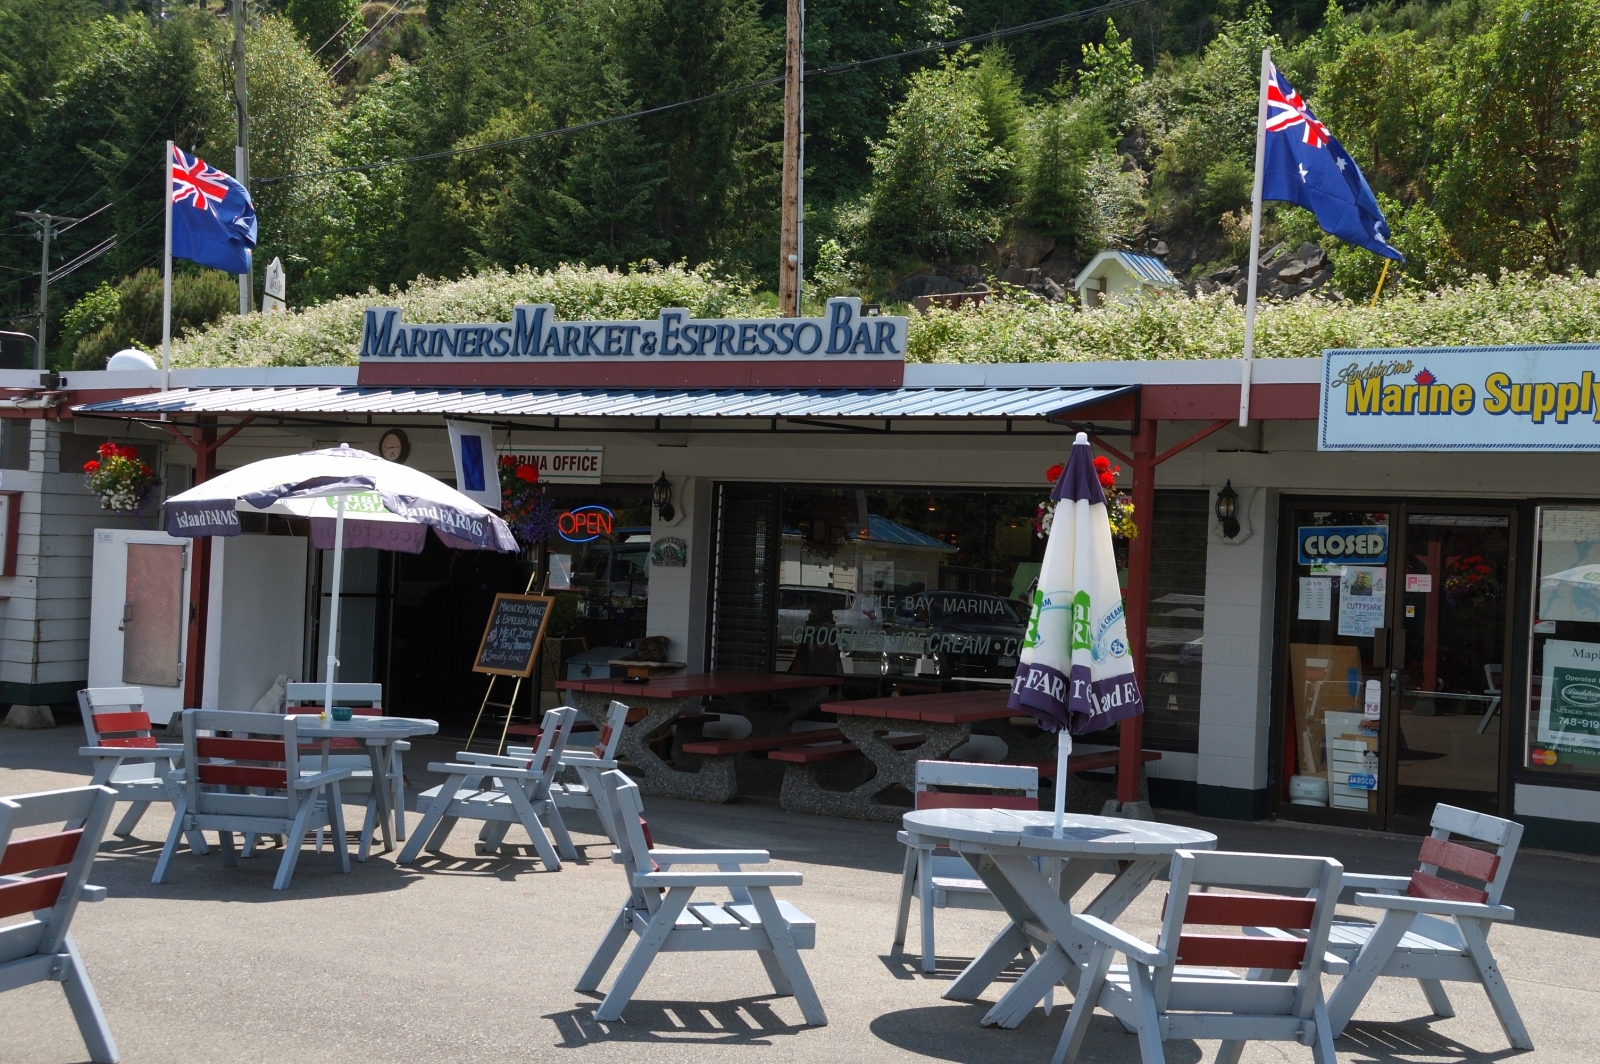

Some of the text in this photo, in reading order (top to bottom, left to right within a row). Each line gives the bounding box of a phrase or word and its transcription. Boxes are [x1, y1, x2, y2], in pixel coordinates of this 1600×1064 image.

[640, 331, 657, 356] &
[659, 313, 822, 357] ESPRESSO
[825, 302, 900, 355] BAR
[1346, 376, 1475, 416] Marine
[553, 455, 598, 471] OFFICE
[558, 511, 612, 534] OPEN
[1303, 534, 1385, 557] CLOSED
[845, 594, 1005, 615] MPLE BAY MARINA
[527, 617, 539, 627] BAR
[792, 625, 888, 649] GROCERIES
[897, 632, 927, 652] ICE
[927, 633, 992, 656] CREAM
[1565, 674, 1596, 683] Operated
[1558, 716, 1600, 729] 748-919
[1349, 775, 1374, 785] JABSCO
